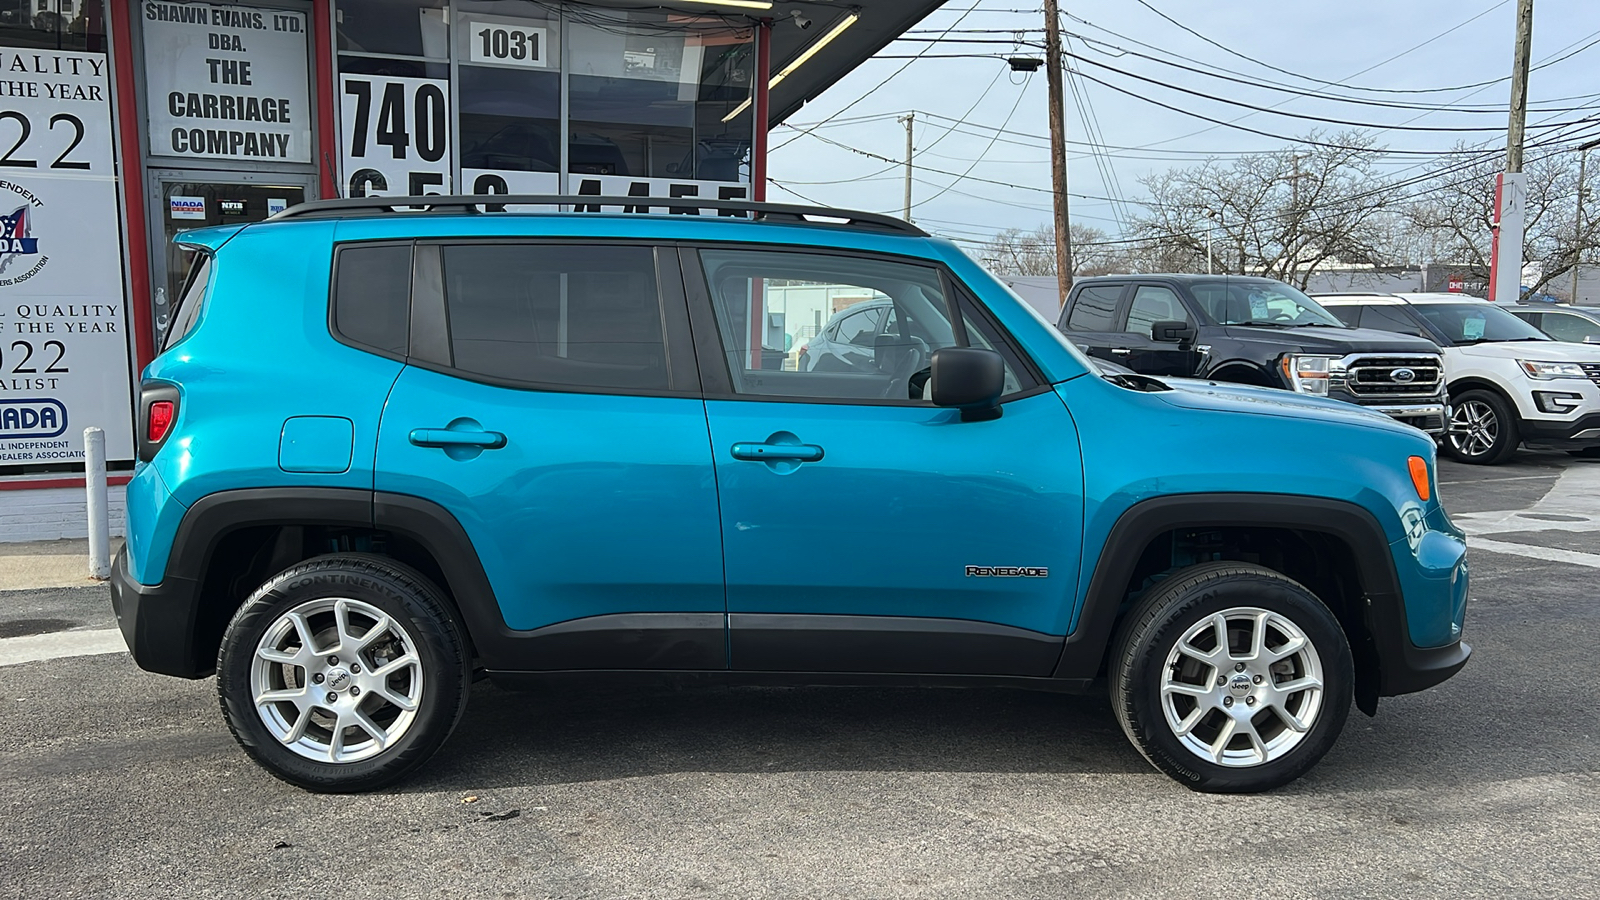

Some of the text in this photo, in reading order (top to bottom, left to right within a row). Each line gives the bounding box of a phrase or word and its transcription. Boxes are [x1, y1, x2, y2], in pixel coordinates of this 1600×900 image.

[146, 3, 304, 33] SHAWN EVANS. LTD.
[208, 33, 246, 52] DBA.
[478, 28, 539, 61] 1031
[0, 53, 104, 77] ALITY
[206, 58, 252, 86] THE
[44, 82, 104, 101] YEAR
[168, 91, 291, 123] CARRIAGE
[345, 79, 446, 163] 740
[171, 127, 290, 158] COMPANY
[14, 255, 49, 285] ASSOCIATION
[17, 304, 118, 319] QUALITY
[14, 322, 55, 334] THE
[64, 322, 117, 334] YEAR
[0, 340, 69, 374] 22
[0, 452, 33, 461] EALERS
[8, 441, 69, 450] INDEPENDENT
[965, 565, 1048, 578] RENEGADE
[288, 574, 413, 615] CONTINENTAL
[331, 673, 346, 686] Jeep
